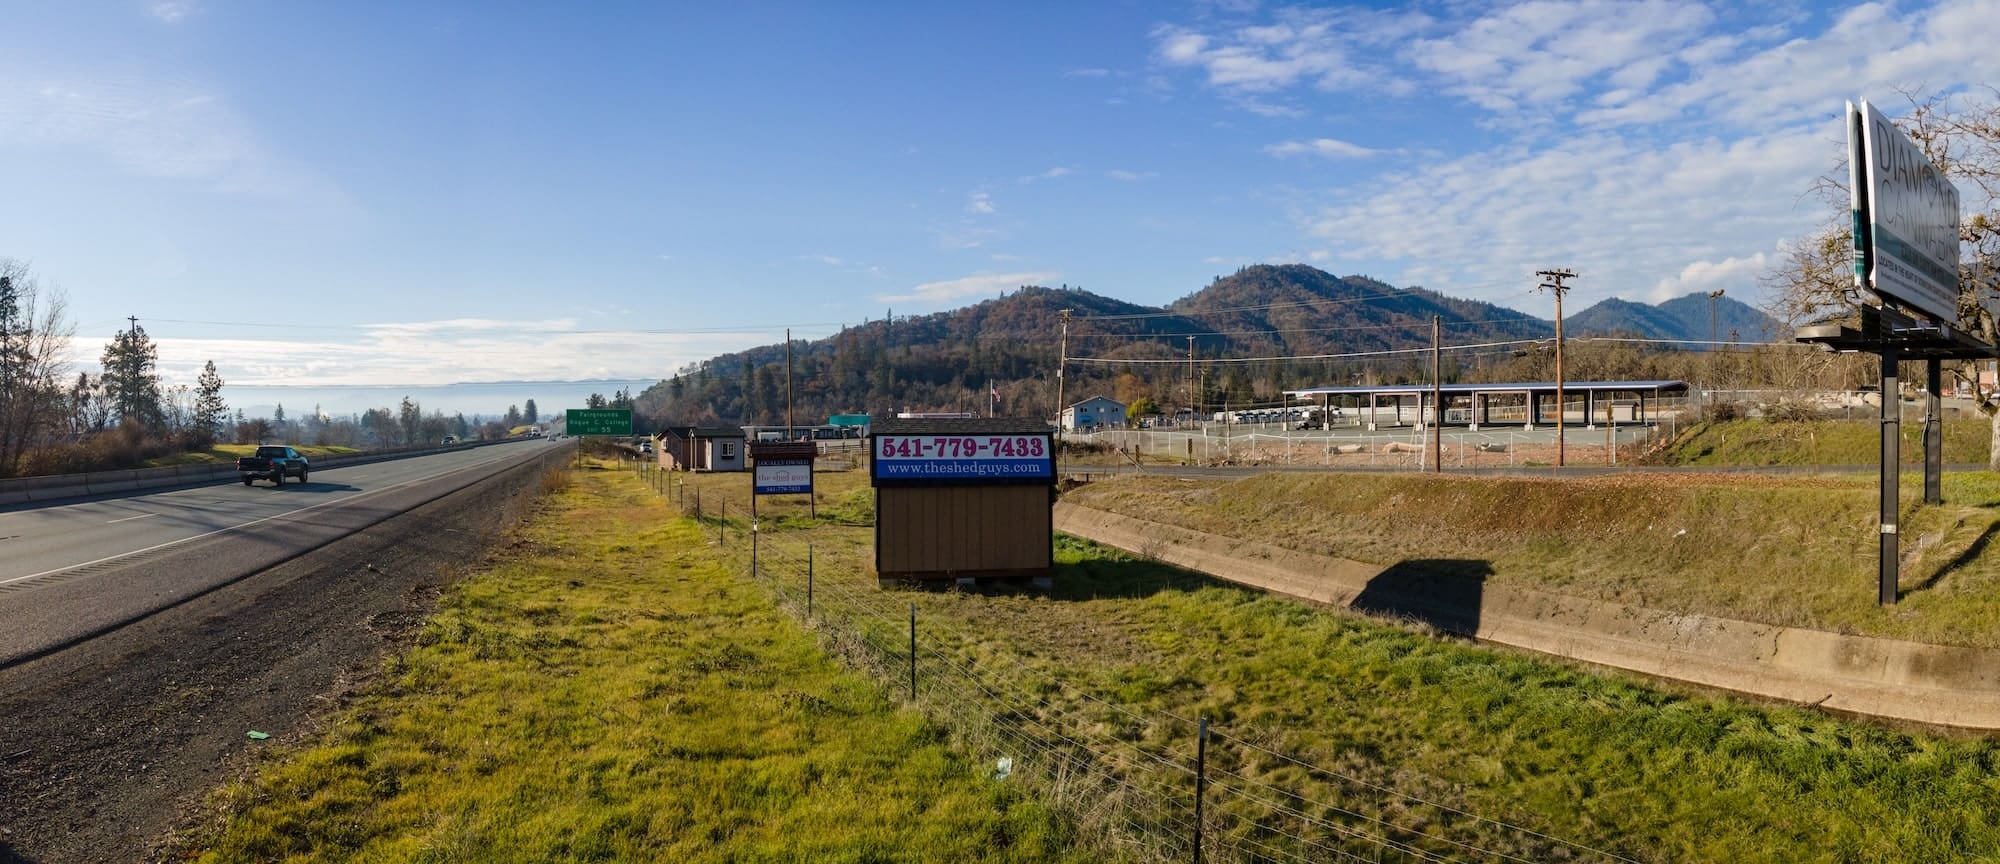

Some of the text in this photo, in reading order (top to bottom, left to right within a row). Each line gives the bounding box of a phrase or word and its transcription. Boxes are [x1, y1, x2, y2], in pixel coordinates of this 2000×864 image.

[1876, 119, 1957, 229] DIAMOND
[1881, 178, 1956, 270] CANNABIS
[882, 438, 1044, 457] 541-779-7433
[758, 472, 772, 481] the
[887, 461, 1041, 476] www.theshedguys.com
